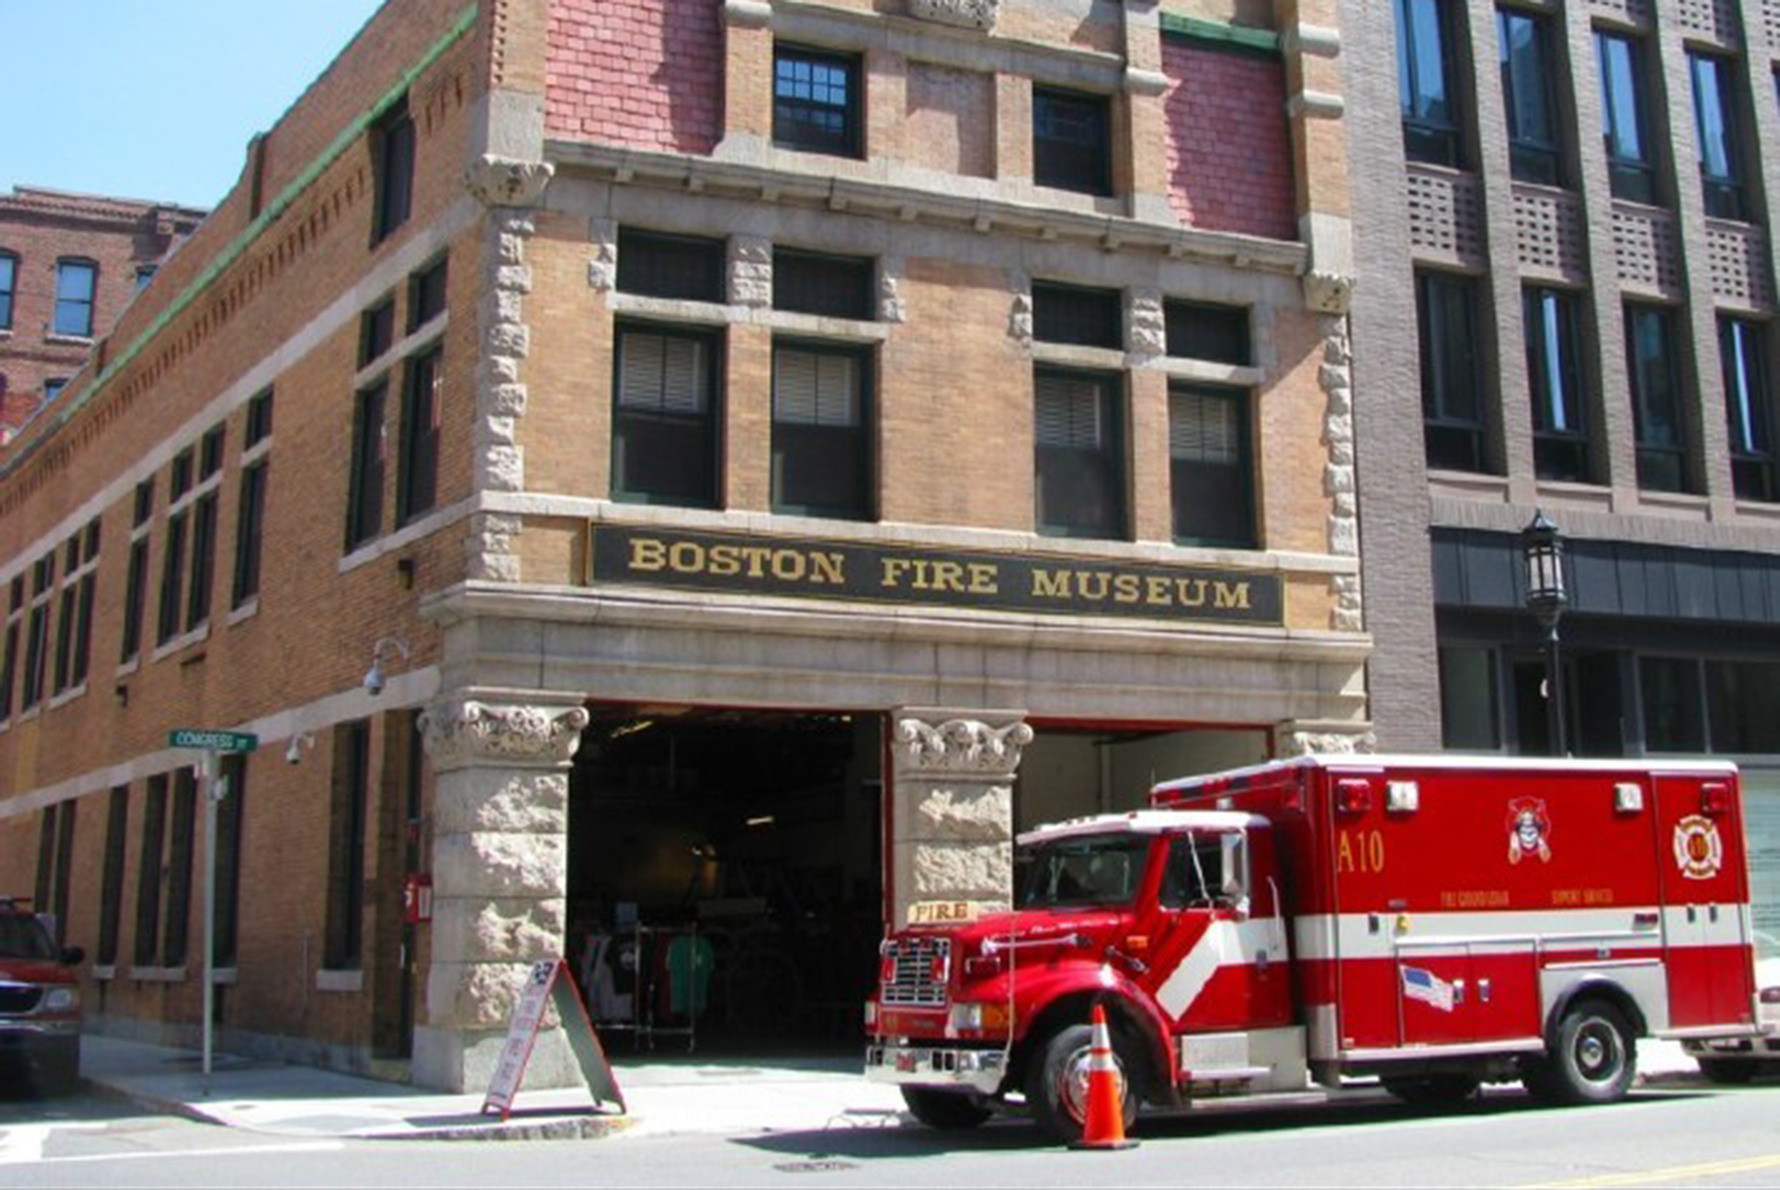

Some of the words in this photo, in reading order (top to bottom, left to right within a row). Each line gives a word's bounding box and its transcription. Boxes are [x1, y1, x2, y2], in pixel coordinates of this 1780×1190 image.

[628, 537, 846, 584] BOSTON
[880, 557, 999, 594] FIRE
[1031, 568, 1251, 610] MUSEUM
[1337, 830, 1384, 873] A10
[916, 902, 968, 920] FIRE
